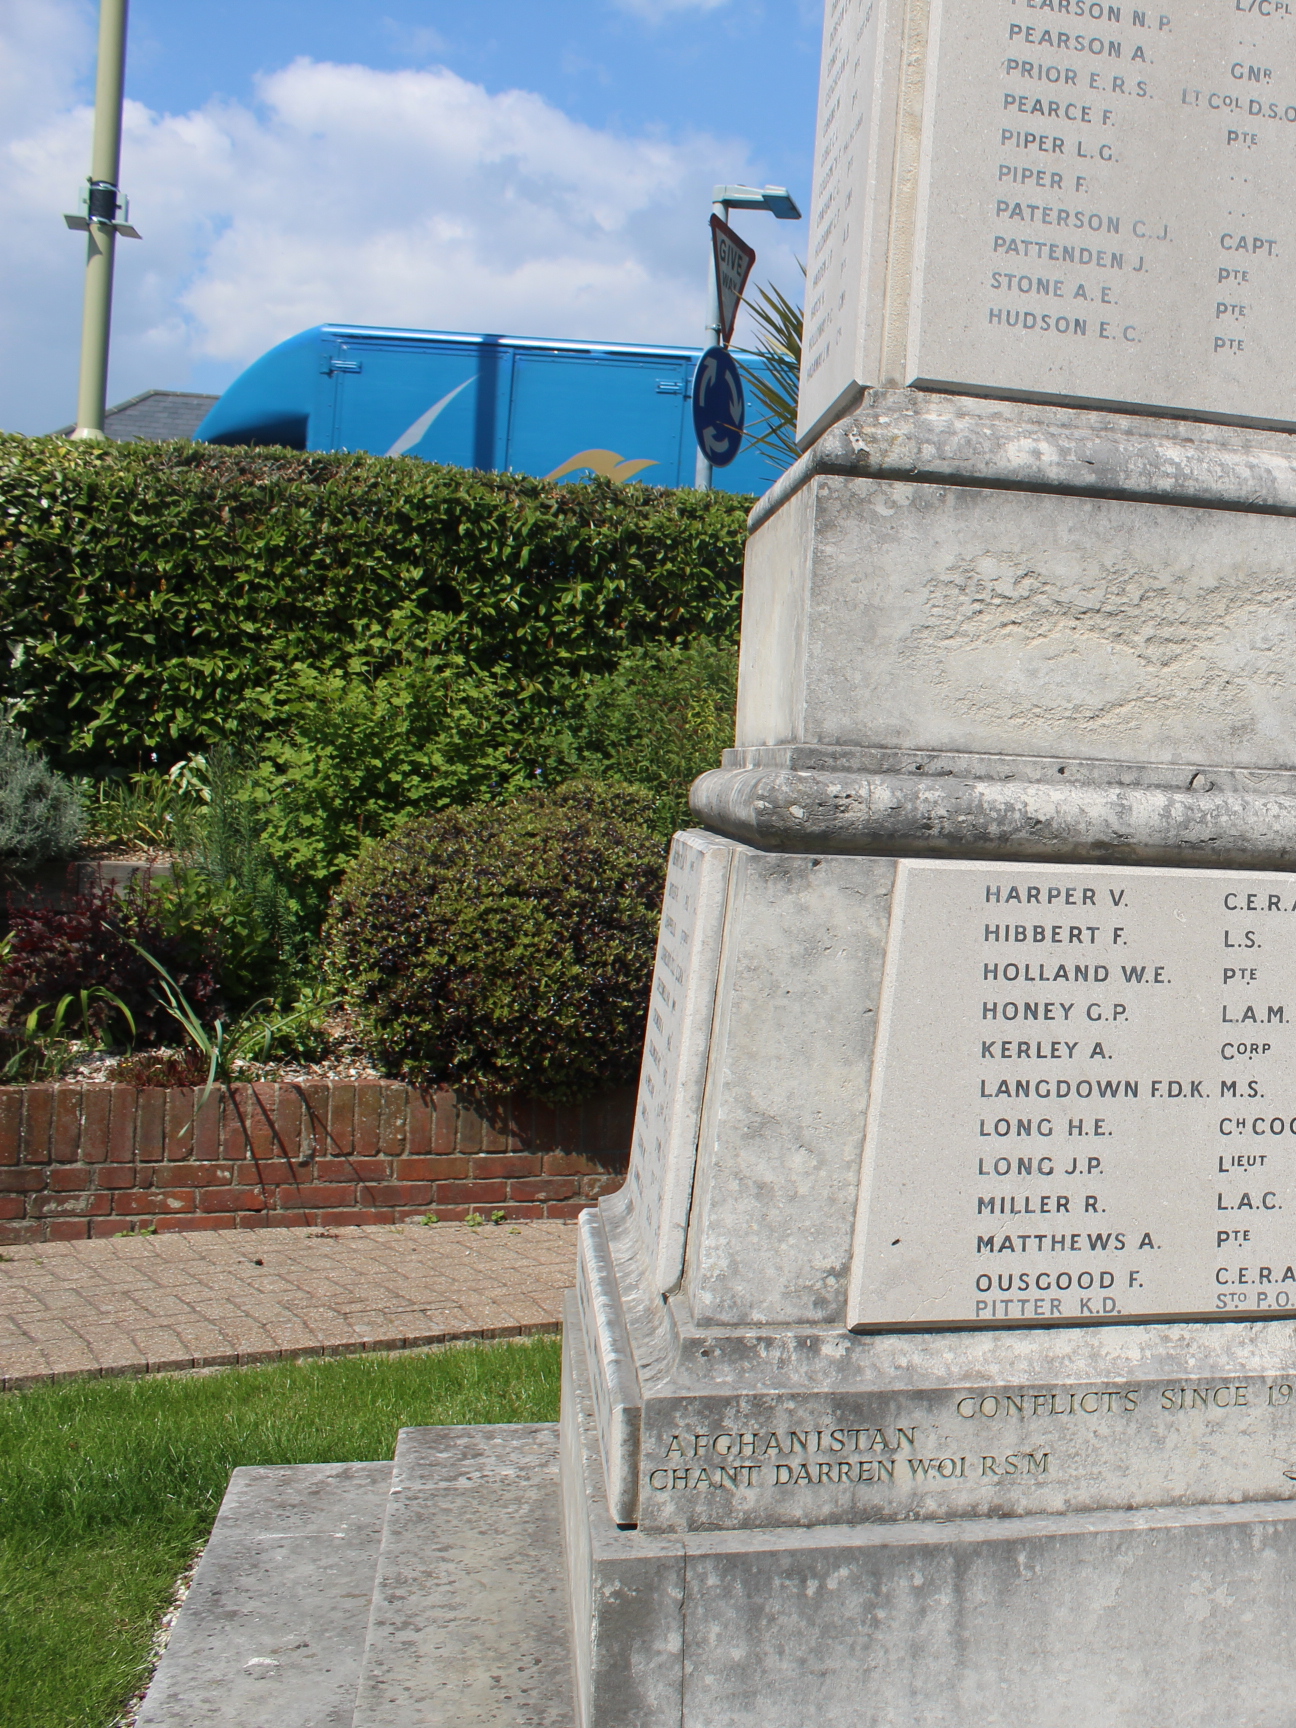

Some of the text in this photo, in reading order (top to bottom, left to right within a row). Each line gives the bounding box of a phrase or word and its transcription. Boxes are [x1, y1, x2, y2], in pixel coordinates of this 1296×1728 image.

[1012, 0, 1120, 23] EARSON
[1010, 23, 1121, 58] PEARSON
[1007, 59, 1077, 86] PRIOR
[1004, 93, 1091, 123] PEARCE
[1002, 129, 1064, 154] PIPER
[999, 165, 1063, 189] PIPER
[997, 200, 1120, 234] PATERSON
[720, 239, 743, 277] GIVE
[994, 236, 1123, 270] PATTENDEN
[722, 270, 738, 291] WAY
[991, 272, 1064, 298] STONE
[989, 308, 1087, 336] HUDSON
[986, 885, 1096, 905] HARPER
[985, 924, 1100, 944] HIBBERT
[984, 963, 1109, 982] HOLLAND
[983, 1002, 1074, 1020] HONEY
[982, 1041, 1079, 1058] KERLEY
[981, 1080, 1138, 1098] LANGDOWN
[980, 1118, 1052, 1137] LONG
[979, 1157, 1054, 1176] LONG
[978, 1196, 1070, 1215] MILLER
[977, 1233, 1125, 1253] MATTHEWS
[976, 1272, 1114, 1292] OUSGOOD
[976, 1298, 1064, 1319] PITTER
[957, 1390, 1138, 1418] CONFLICTS
[1161, 1386, 1249, 1411] SINCE
[664, 1427, 917, 1459] AFGHANISTAN
[650, 1465, 762, 1490] CHANT
[774, 1459, 898, 1487] DARREN
